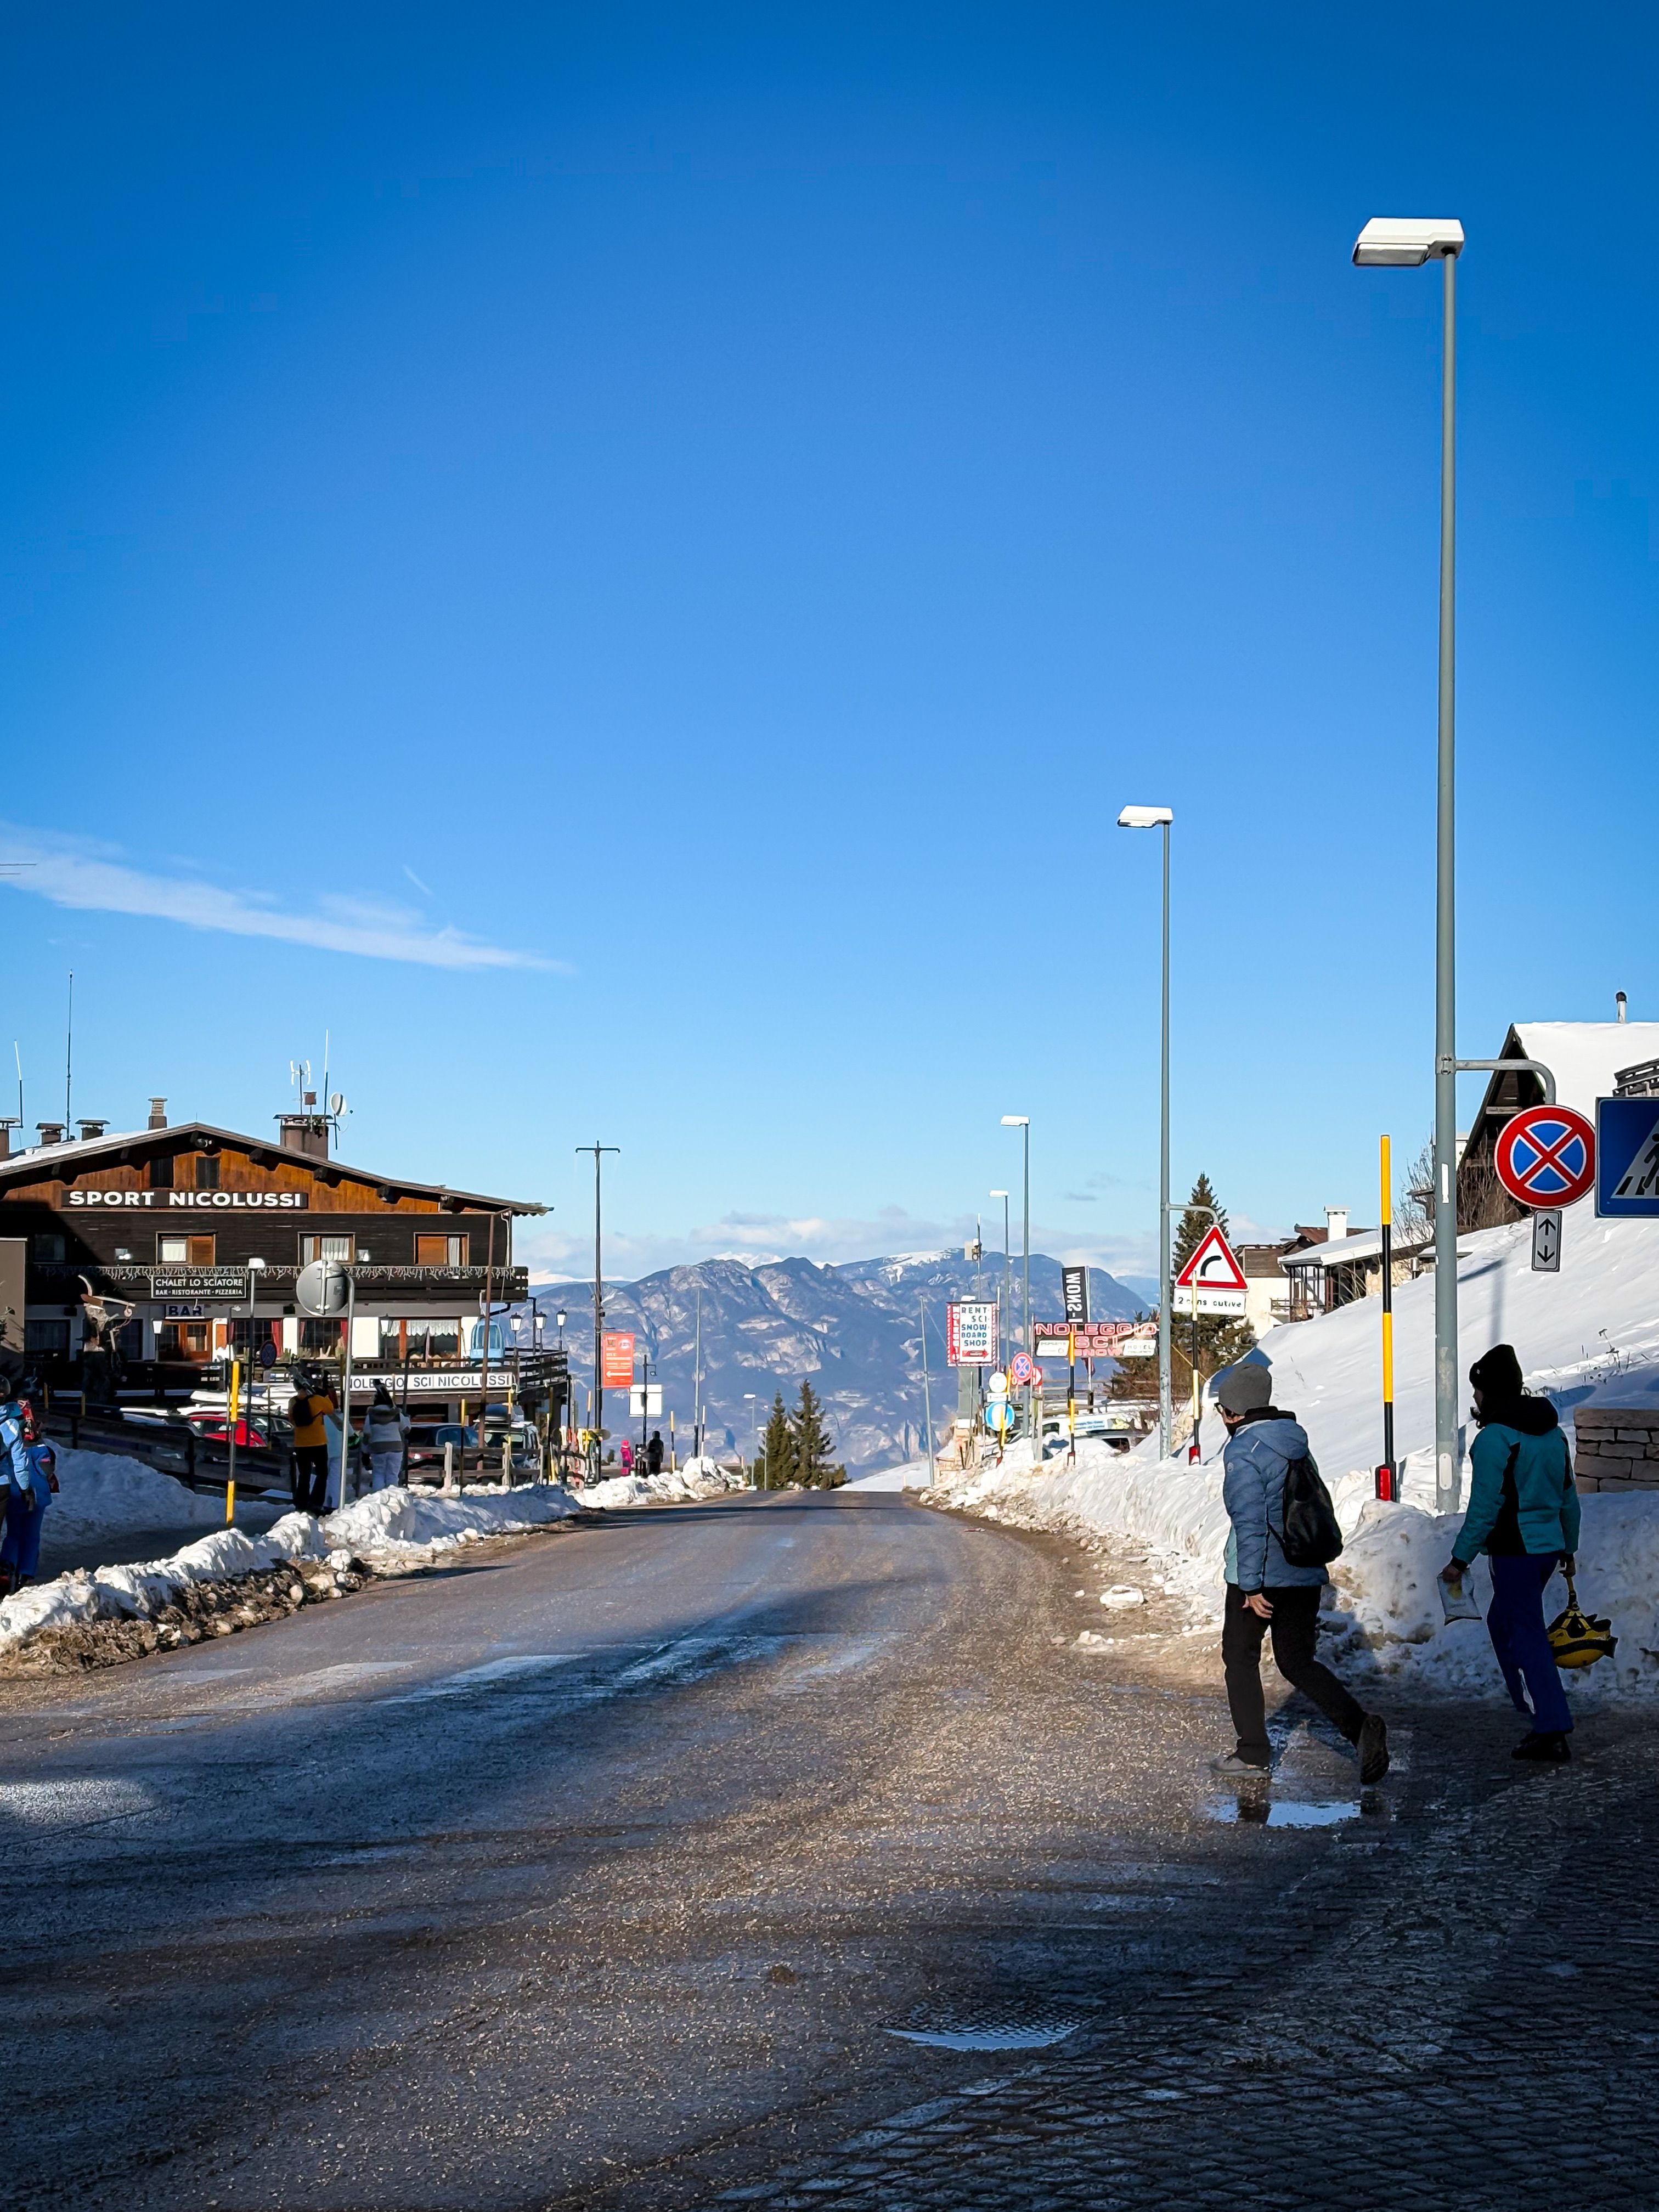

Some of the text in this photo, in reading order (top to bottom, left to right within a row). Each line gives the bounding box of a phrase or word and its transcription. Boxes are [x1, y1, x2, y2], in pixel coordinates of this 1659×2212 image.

[69, 1191, 301, 1207] SPORT NICOLUSSI
[168, 1305, 202, 1316] BAR
[1035, 1323, 1158, 1336] NOLEGGIO
[1074, 1336, 1118, 1348] SCI
[414, 1377, 431, 1387] SCI
